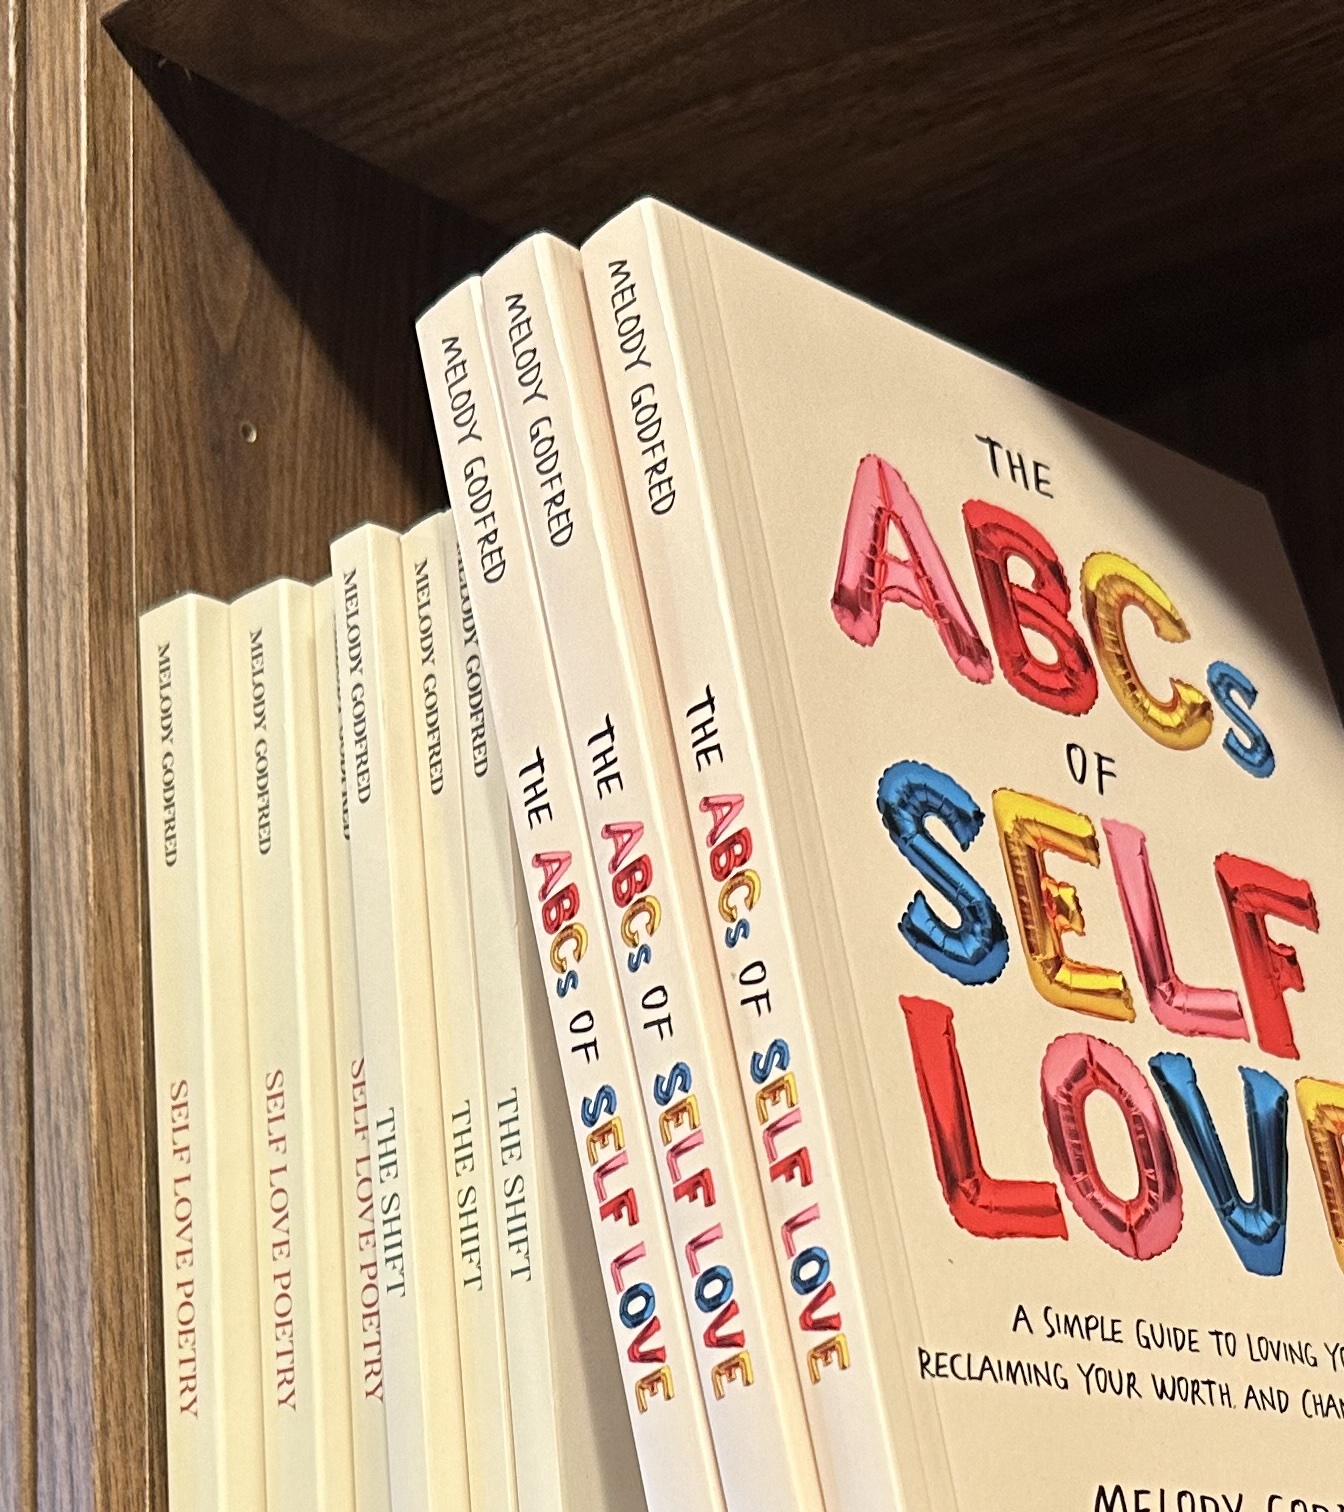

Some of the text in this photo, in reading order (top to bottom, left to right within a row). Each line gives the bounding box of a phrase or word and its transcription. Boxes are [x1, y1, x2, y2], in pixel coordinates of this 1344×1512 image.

[441, 336, 507, 586] MELODY GODFRED
[505, 293, 573, 549] MELODY GODFRED
[609, 259, 677, 516] MELODY GODFRED
[976, 434, 1055, 500] THE
[343, 567, 372, 804] MELODY GODFRED
[414, 558, 444, 796] MELODY GODFRED
[466, 654, 489, 778] GODFRED
[831, 453, 1276, 779] ABCs
[157, 641, 178, 868] MELODY GODFRED
[250, 627, 272, 856] MELODY GODFRED
[1067, 743, 1117, 796] OF
[877, 760, 1320, 1060] SELF
[518, 747, 675, 1414] THE ABCs OF SELF LOVE
[586, 713, 754, 1402] THE ABCs OF SELF LOVE
[685, 685, 850, 1385] THE ABCs OF SELF LOVE
[170, 1079, 199, 1420] SELF LOVE POETRY
[266, 1069, 297, 1413] SELF LOVE POETRY
[355, 1155, 378, 1251] LOVE
[376, 1107, 407, 1298] THE SHIFT
[452, 1099, 483, 1292] THE SHIFT
[497, 1087, 532, 1283] THE SHIFT
[360, 1260, 385, 1406] POETRY
[918, 1347, 1068, 1391] RECLAIMING
[1077, 1362, 1142, 1398] YOUR
[1244, 1387, 1289, 1414] AND
[1012, 1305, 1033, 1335] A
[1044, 1306, 1123, 1344] SIMPLE
[1136, 1318, 1199, 1353] GUIDE
[1208, 1330, 1236, 1357] TO
[1246, 1333, 1317, 1368] LOVING
